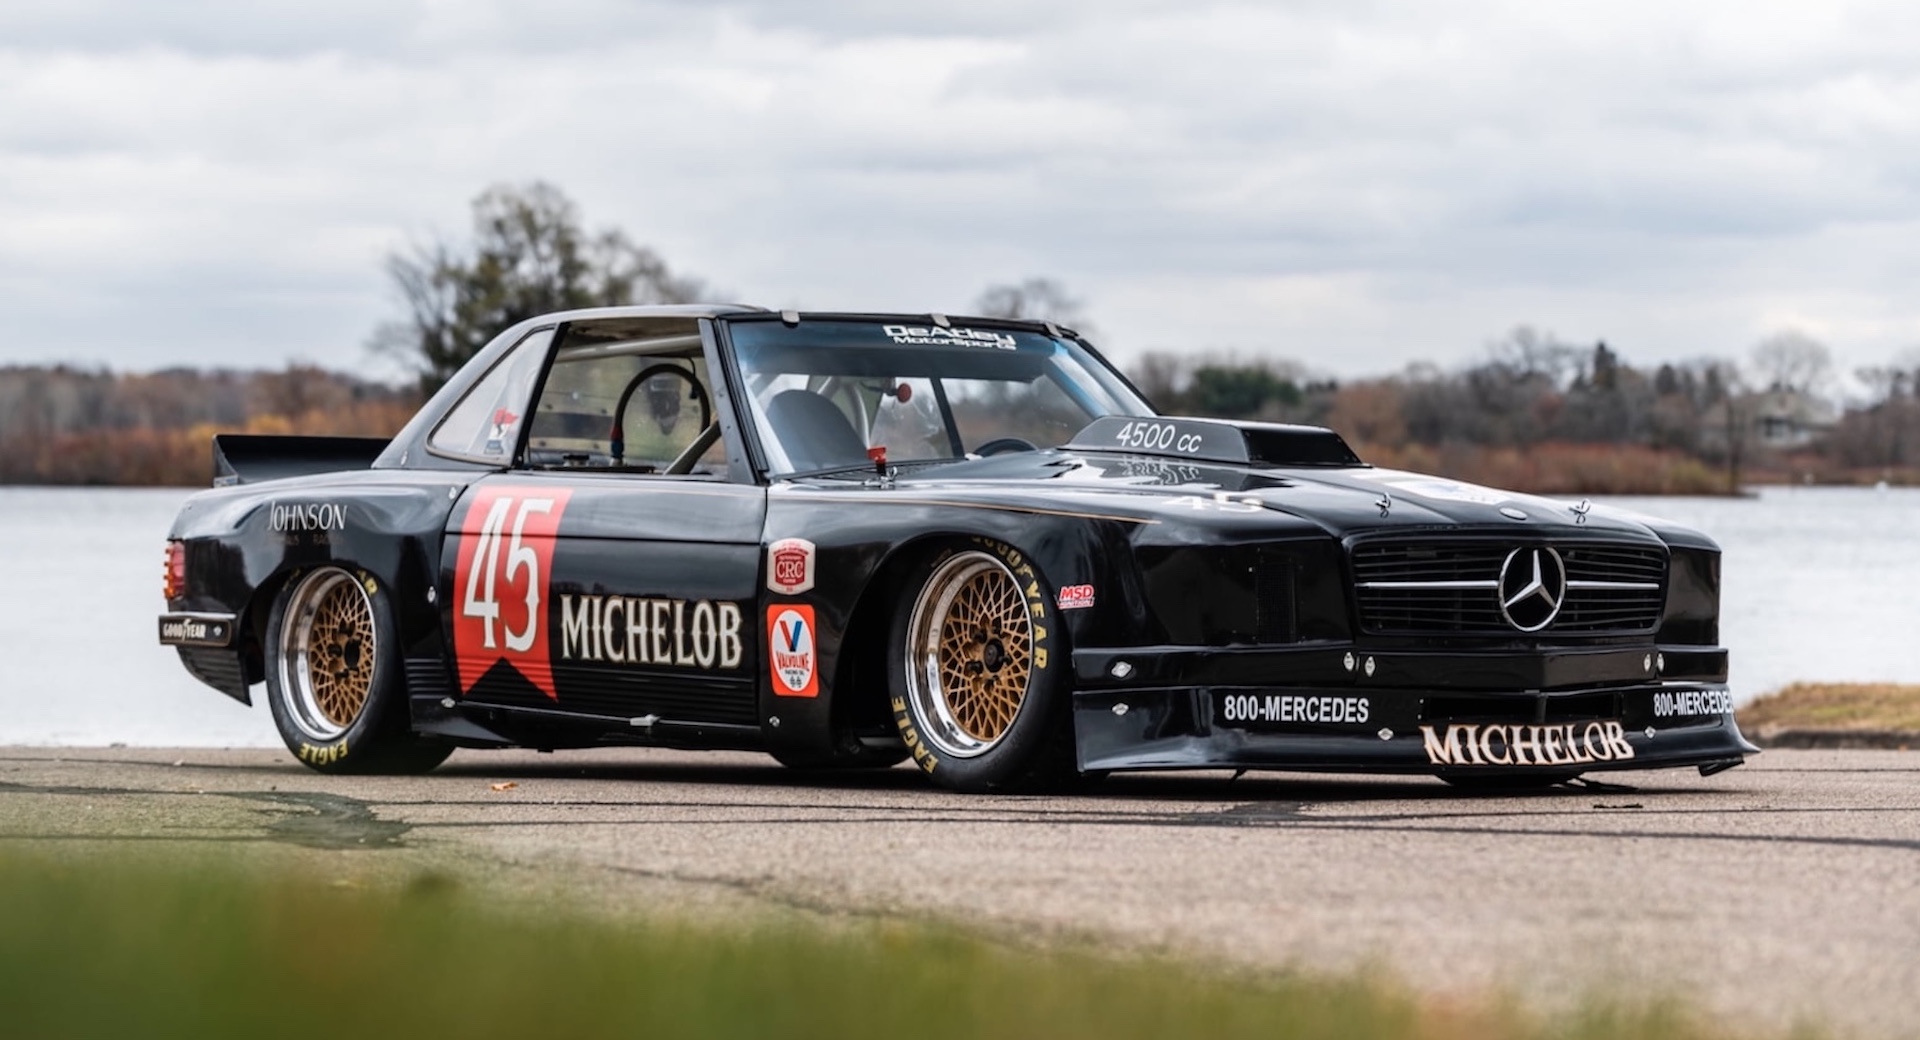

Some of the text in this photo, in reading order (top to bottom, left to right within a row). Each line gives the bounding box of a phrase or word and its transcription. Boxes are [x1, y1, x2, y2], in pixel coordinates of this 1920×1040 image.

[883, 325, 1017, 344] DeAtley
[893, 336, 1017, 350] Motorsports
[1116, 421, 1202, 453] 4500 cc
[267, 501, 348, 532] JOHNSON
[463, 497, 555, 653] 45
[776, 560, 804, 579] CRC
[1060, 586, 1093, 600] MSD
[560, 594, 743, 669] MICHELOB
[1224, 695, 1369, 723] 800-MERCEDES
[1653, 691, 1734, 717] 800-MERCEDE
[892, 696, 939, 774] EAGLE
[1419, 720, 1635, 766] MICHELOB
[299, 737, 348, 765] EAGLE
